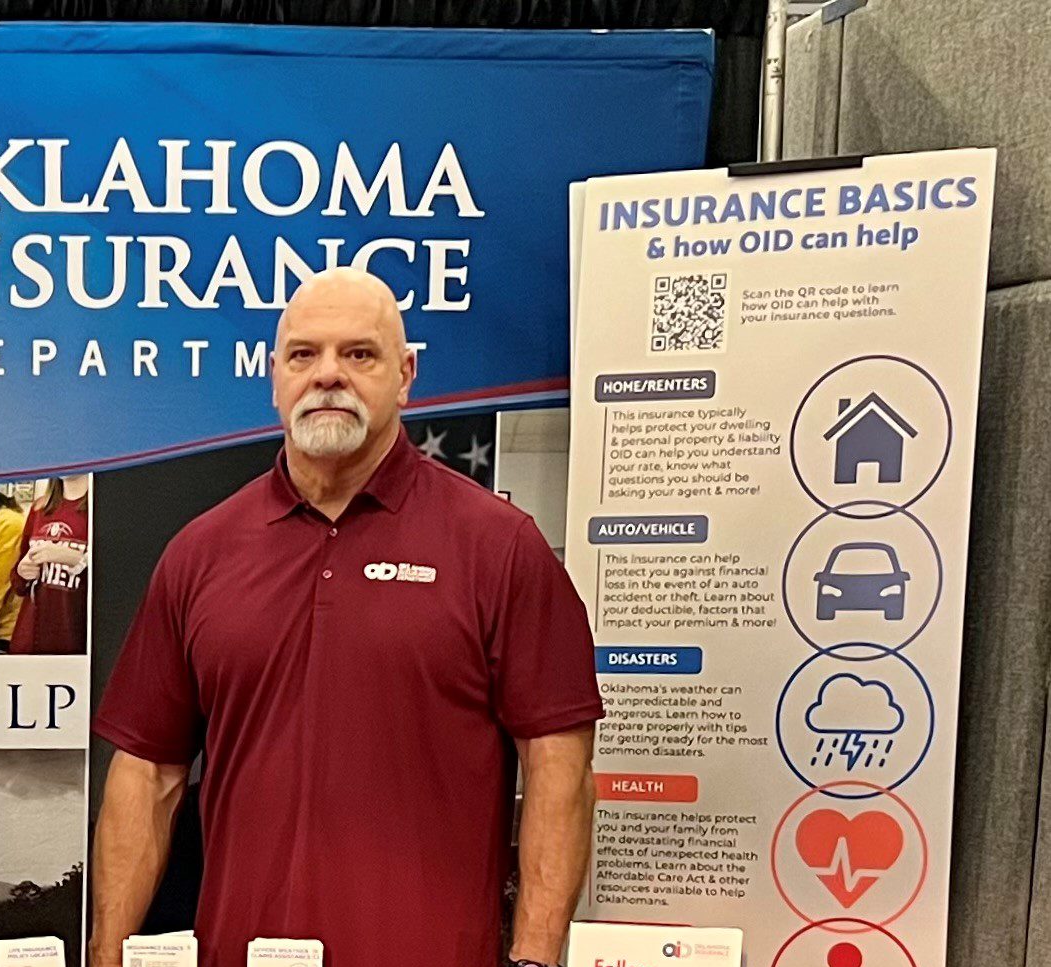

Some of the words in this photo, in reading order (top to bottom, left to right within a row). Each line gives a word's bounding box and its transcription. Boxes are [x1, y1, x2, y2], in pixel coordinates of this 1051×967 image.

[599, 188, 826, 231] INSURANCE
[838, 177, 978, 216] BASICS
[646, 237, 665, 259] &
[673, 234, 731, 258] how
[739, 229, 793, 254] OID
[801, 228, 847, 250] can
[856, 222, 919, 250] help
[742, 289, 771, 299] Scan
[774, 287, 794, 298] the
[797, 286, 816, 296] QR
[818, 285, 848, 296] code
[851, 284, 864, 294] to
[867, 283, 900, 293] learn
[741, 299, 767, 309] how
[770, 297, 793, 308] OID
[796, 299, 818, 307] can
[821, 296, 848, 309] help
[851, 295, 879, 306] with
[740, 313, 766, 324] your
[770, 310, 830, 320] insurance
[603, 377, 708, 393] HOME/RENTERS
[613, 409, 635, 419] This
[637, 409, 695, 419] insurance
[697, 407, 746, 420] typically
[611, 422, 642, 434] helps
[644, 421, 687, 434] protect
[690, 423, 716, 433] your
[719, 420, 771, 432] dwelling
[598, 522, 696, 536] AUTO/VEHICLE
[605, 554, 628, 563] This
[630, 553, 687, 563] insurance
[713, 553, 740, 565] help
[605, 566, 645, 578] protect
[648, 569, 670, 578] you
[672, 566, 715, 578] against
[718, 566, 769, 576] financial
[603, 592, 652, 601] accident
[703, 592, 737, 601] Learn
[739, 592, 775, 601] about
[609, 653, 678, 666] DISASTERS
[600, 683, 667, 693] Oklahoma's
[670, 684, 717, 694] weather
[599, 723, 643, 733] prepare
[646, 722, 694, 734] properly
[696, 722, 723, 732] with
[725, 722, 747, 735] tips
[612, 781, 664, 793] HEALTH
[597, 810, 620, 820] This
[622, 810, 677, 821] insurance
[680, 812, 712, 825] helps
[714, 813, 757, 825] protect
[597, 846, 634, 857] effects
[636, 847, 648, 857] of
[650, 849, 718, 861] unexpected
[721, 850, 758, 860] health
